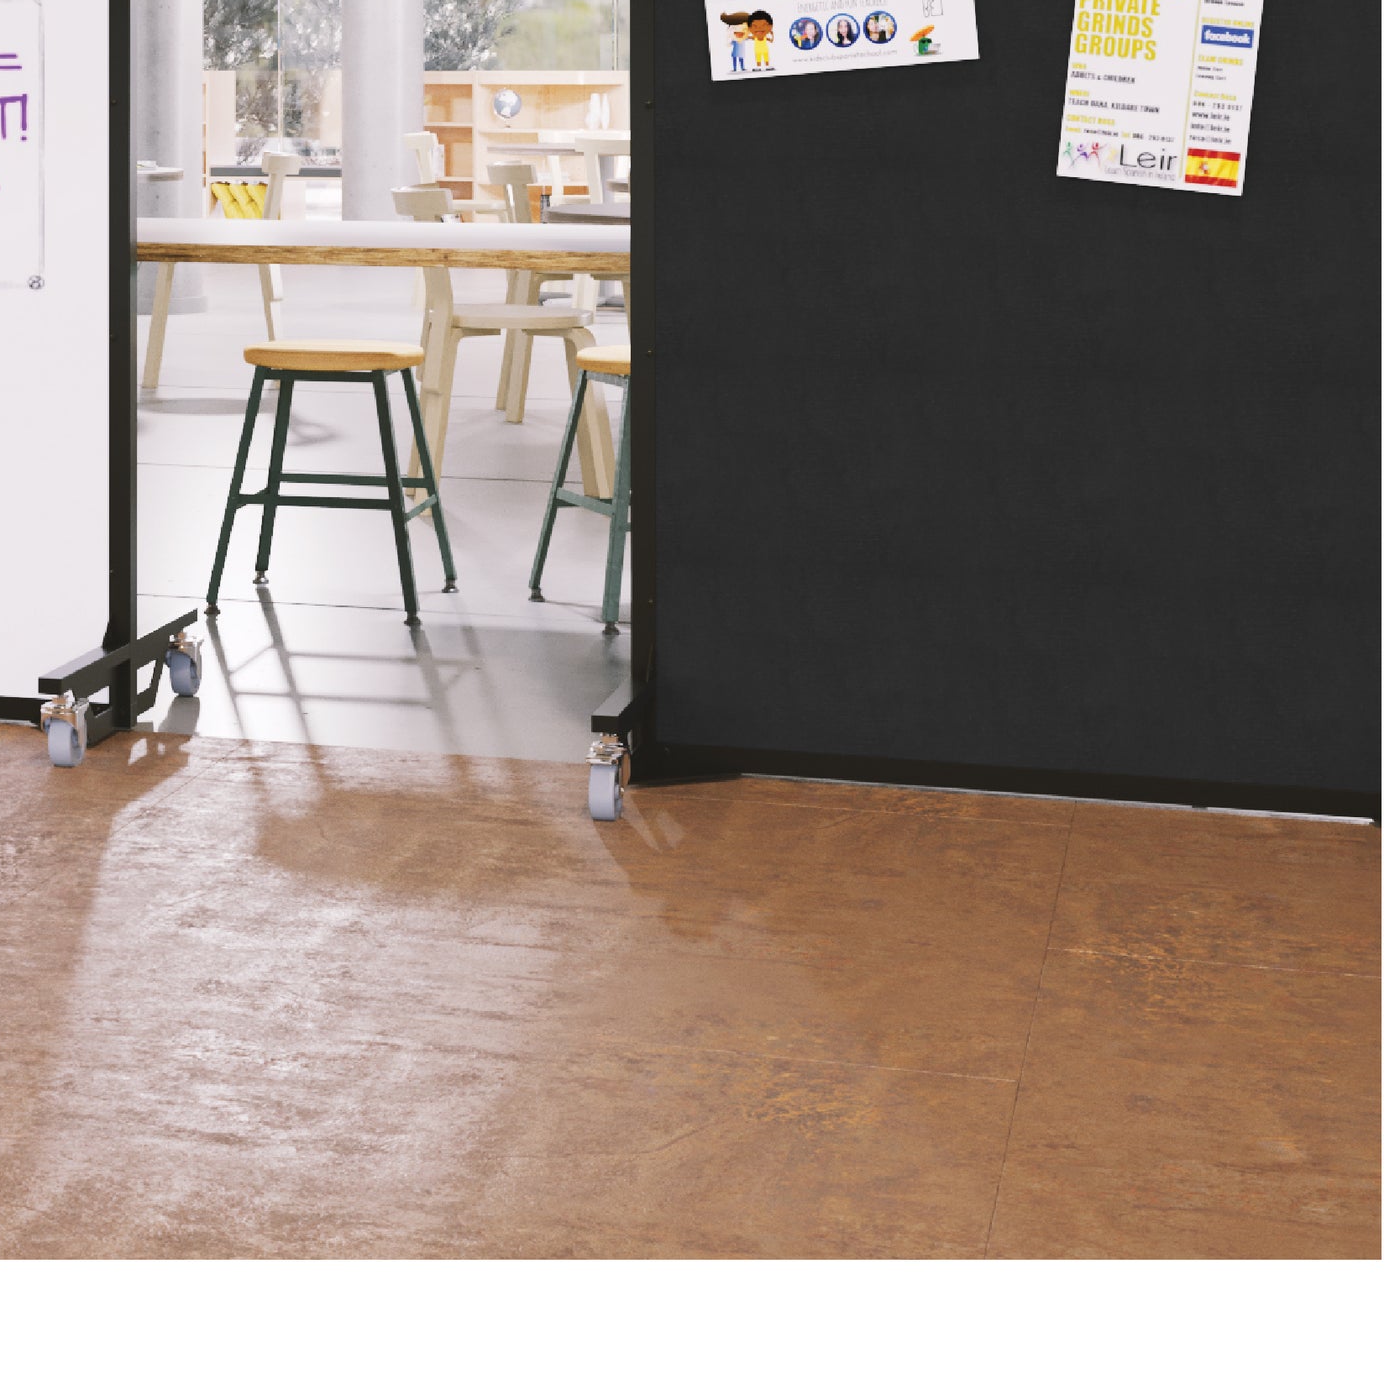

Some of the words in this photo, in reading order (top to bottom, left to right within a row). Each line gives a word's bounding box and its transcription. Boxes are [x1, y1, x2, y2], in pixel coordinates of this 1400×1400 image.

[1077, 11, 1153, 38] GRINDS
[1074, 34, 1156, 60] GROUPS
[1120, 144, 1177, 170] Leir
